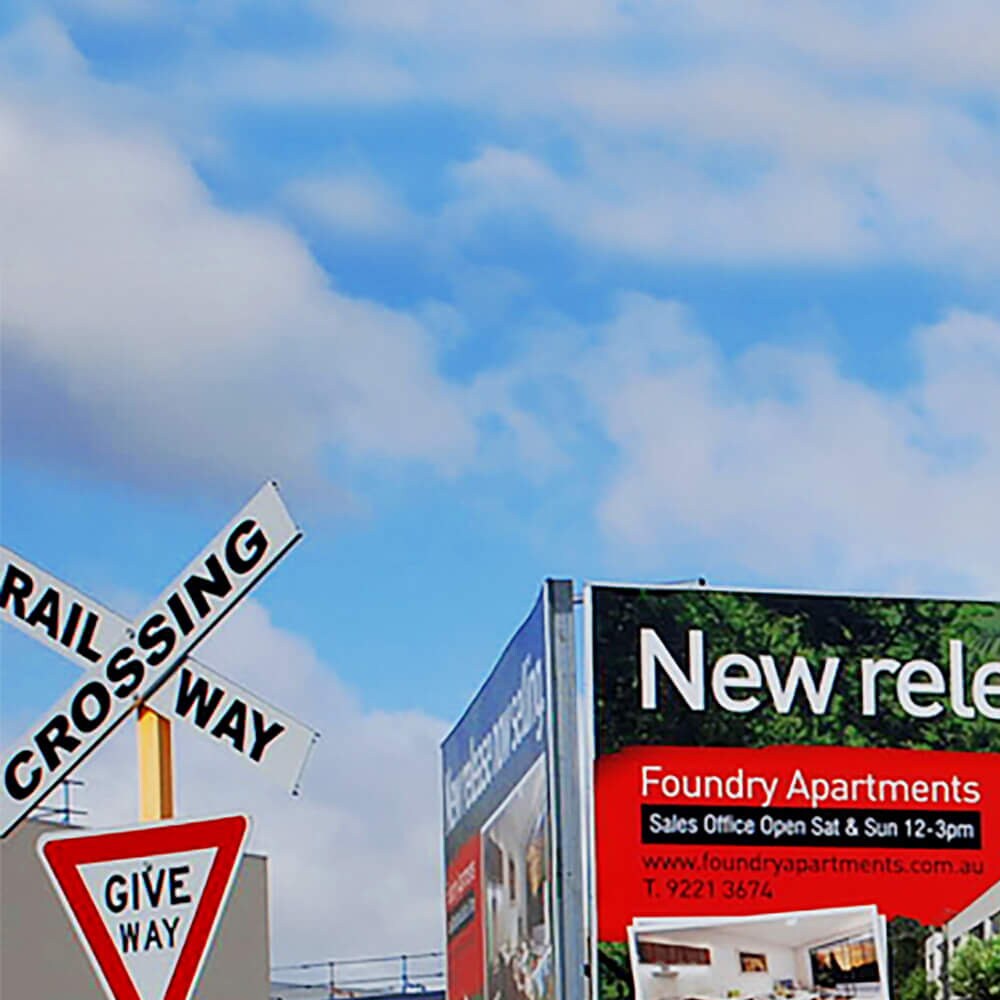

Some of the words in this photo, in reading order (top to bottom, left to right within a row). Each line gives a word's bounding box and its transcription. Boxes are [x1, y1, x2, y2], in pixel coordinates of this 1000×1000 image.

[0, 564, 102, 663] RAIL
[3, 518, 270, 802] CROSSING
[640, 627, 840, 715] New
[173, 668, 284, 764] WAY
[642, 766, 778, 807] Foundry
[787, 769, 981, 808] Apartments
[650, 813, 698, 835] Sales
[703, 814, 756, 835] Office
[760, 816, 806, 839] Open
[811, 817, 841, 837] Sat
[845, 817, 859, 837] &
[864, 818, 898, 838] Sun
[904, 819, 975, 842] 12-3pm
[643, 853, 984, 876] www.foundryapartments.com.au
[104, 864, 191, 914] GIVE
[643, 878, 659, 898] T.
[666, 878, 716, 899] 9221
[723, 880, 773, 899] 3674
[119, 917, 180, 953] WAY
